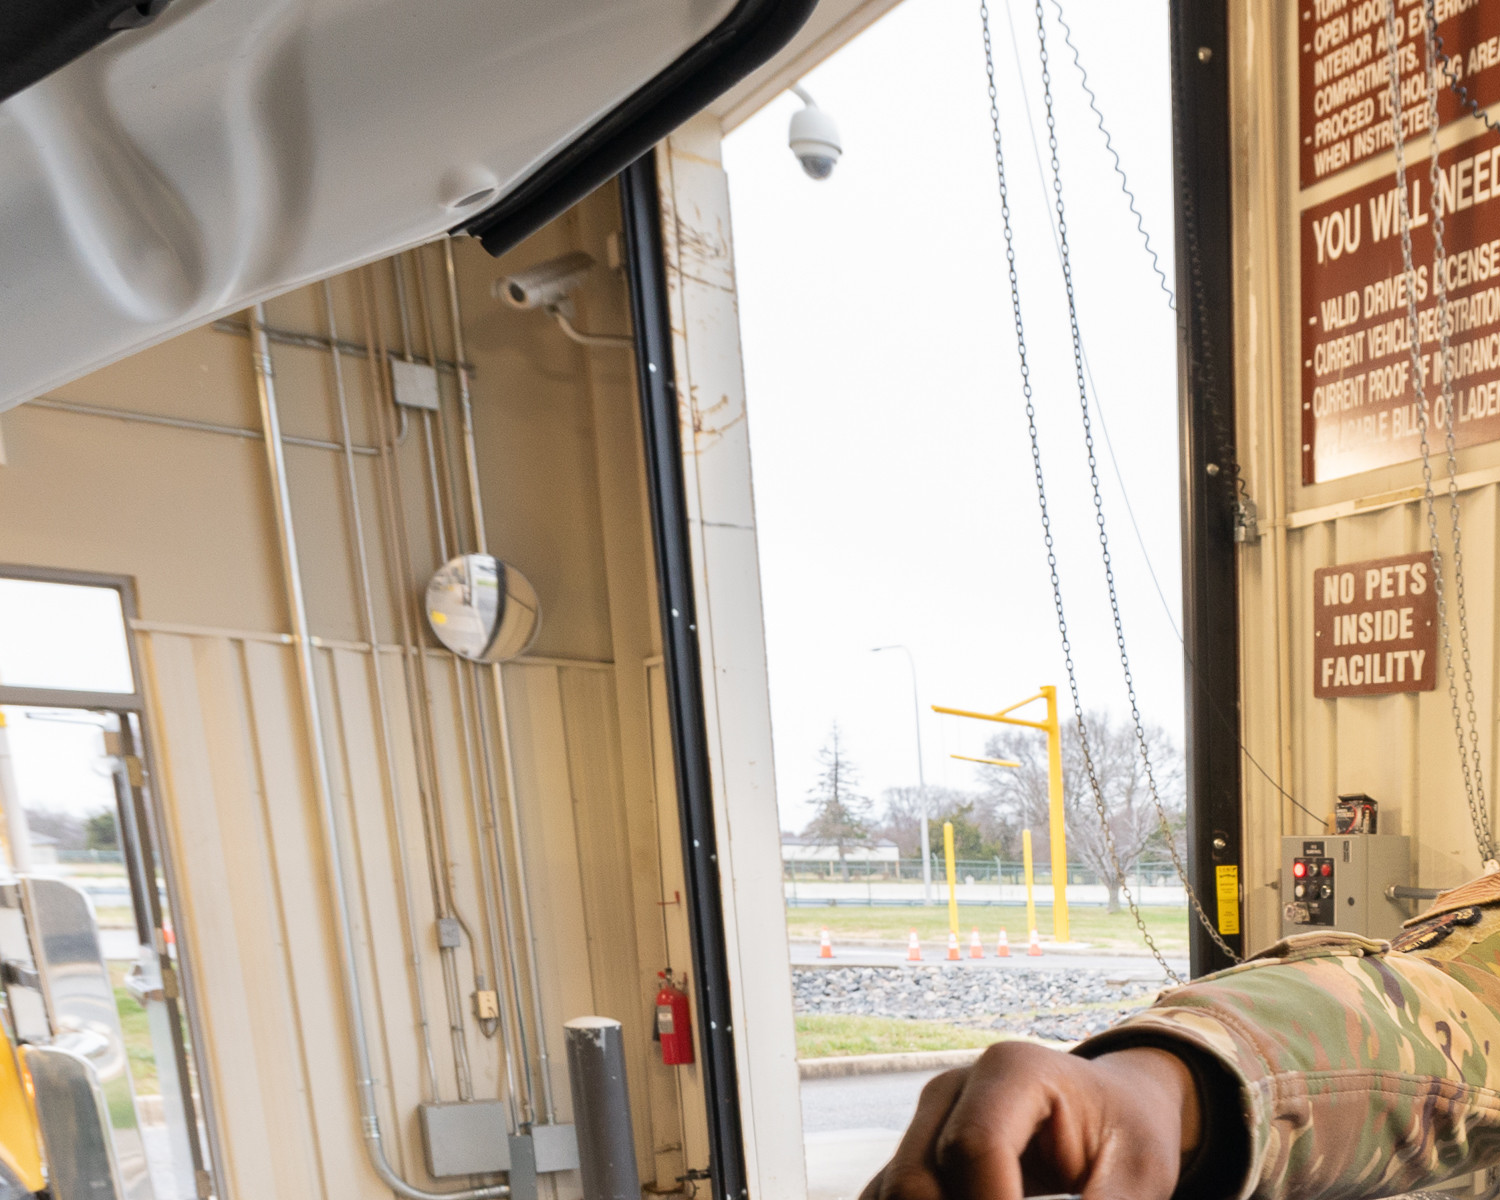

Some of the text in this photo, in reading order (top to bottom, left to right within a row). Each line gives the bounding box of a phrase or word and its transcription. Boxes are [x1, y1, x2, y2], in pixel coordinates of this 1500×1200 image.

[1314, 0, 1391, 55] OPEN HOO
[1314, 33, 1372, 87] INTERIOR
[1315, 97, 1375, 148] PROCEED
[1401, 54, 1463, 107] HOLING
[1314, 138, 1351, 178] WHEN
[1313, 204, 1361, 264] YOU
[1369, 179, 1429, 244] WIL
[1321, 290, 1361, 332] VALID
[1314, 331, 1366, 377] CURRENT
[1313, 374, 1367, 418] CURRENT
[1369, 361, 1410, 404] PROOF
[1413, 354, 1430, 389] F
[1434, 391, 1455, 430] O
[1323, 562, 1428, 606] NO PETS
[1333, 607, 1414, 646] INSIDE
[1321, 649, 1427, 688] FACILITY
